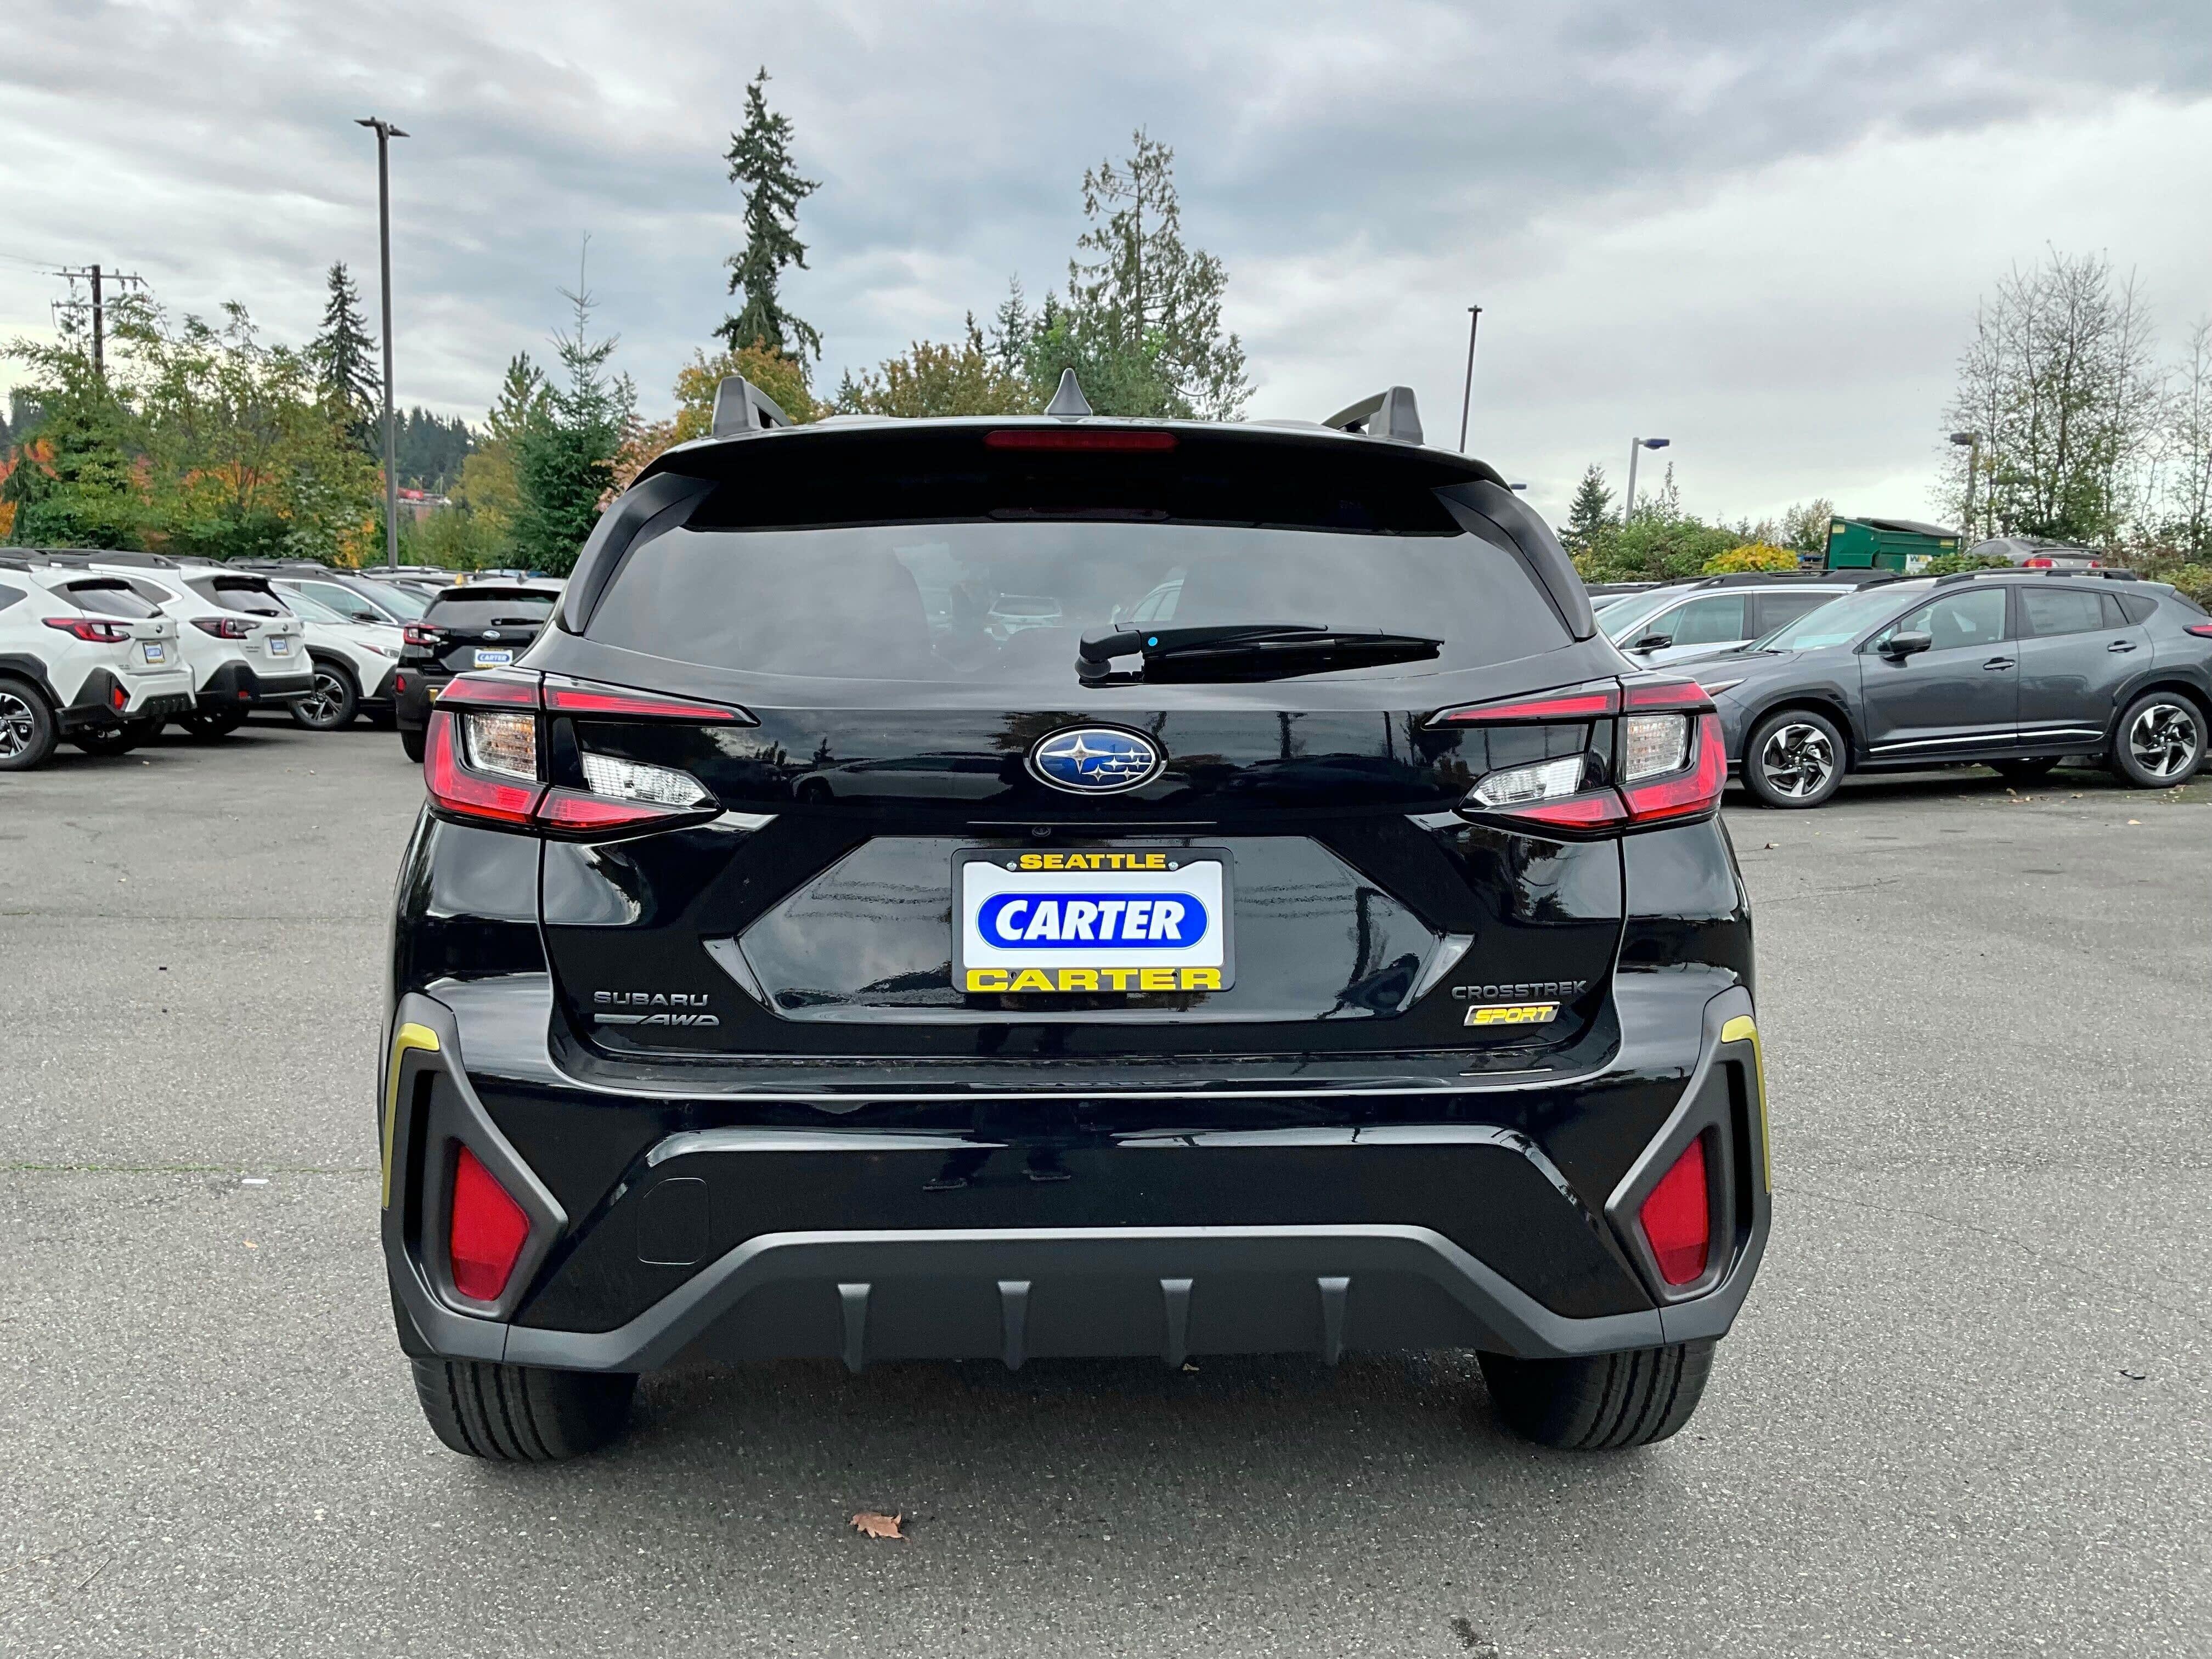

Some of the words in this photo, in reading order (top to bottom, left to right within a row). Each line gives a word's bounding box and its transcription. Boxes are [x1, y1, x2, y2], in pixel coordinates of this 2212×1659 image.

[1019, 854, 1166, 870] SEATTLE
[995, 900, 1186, 941] CARTER
[966, 968, 1221, 992] CARTER
[594, 991, 709, 1007] SUBARU
[1452, 980, 1587, 1000] CROSSTREK
[640, 1014, 720, 1026] AWD
[1472, 1006, 1554, 1025] SPORT
